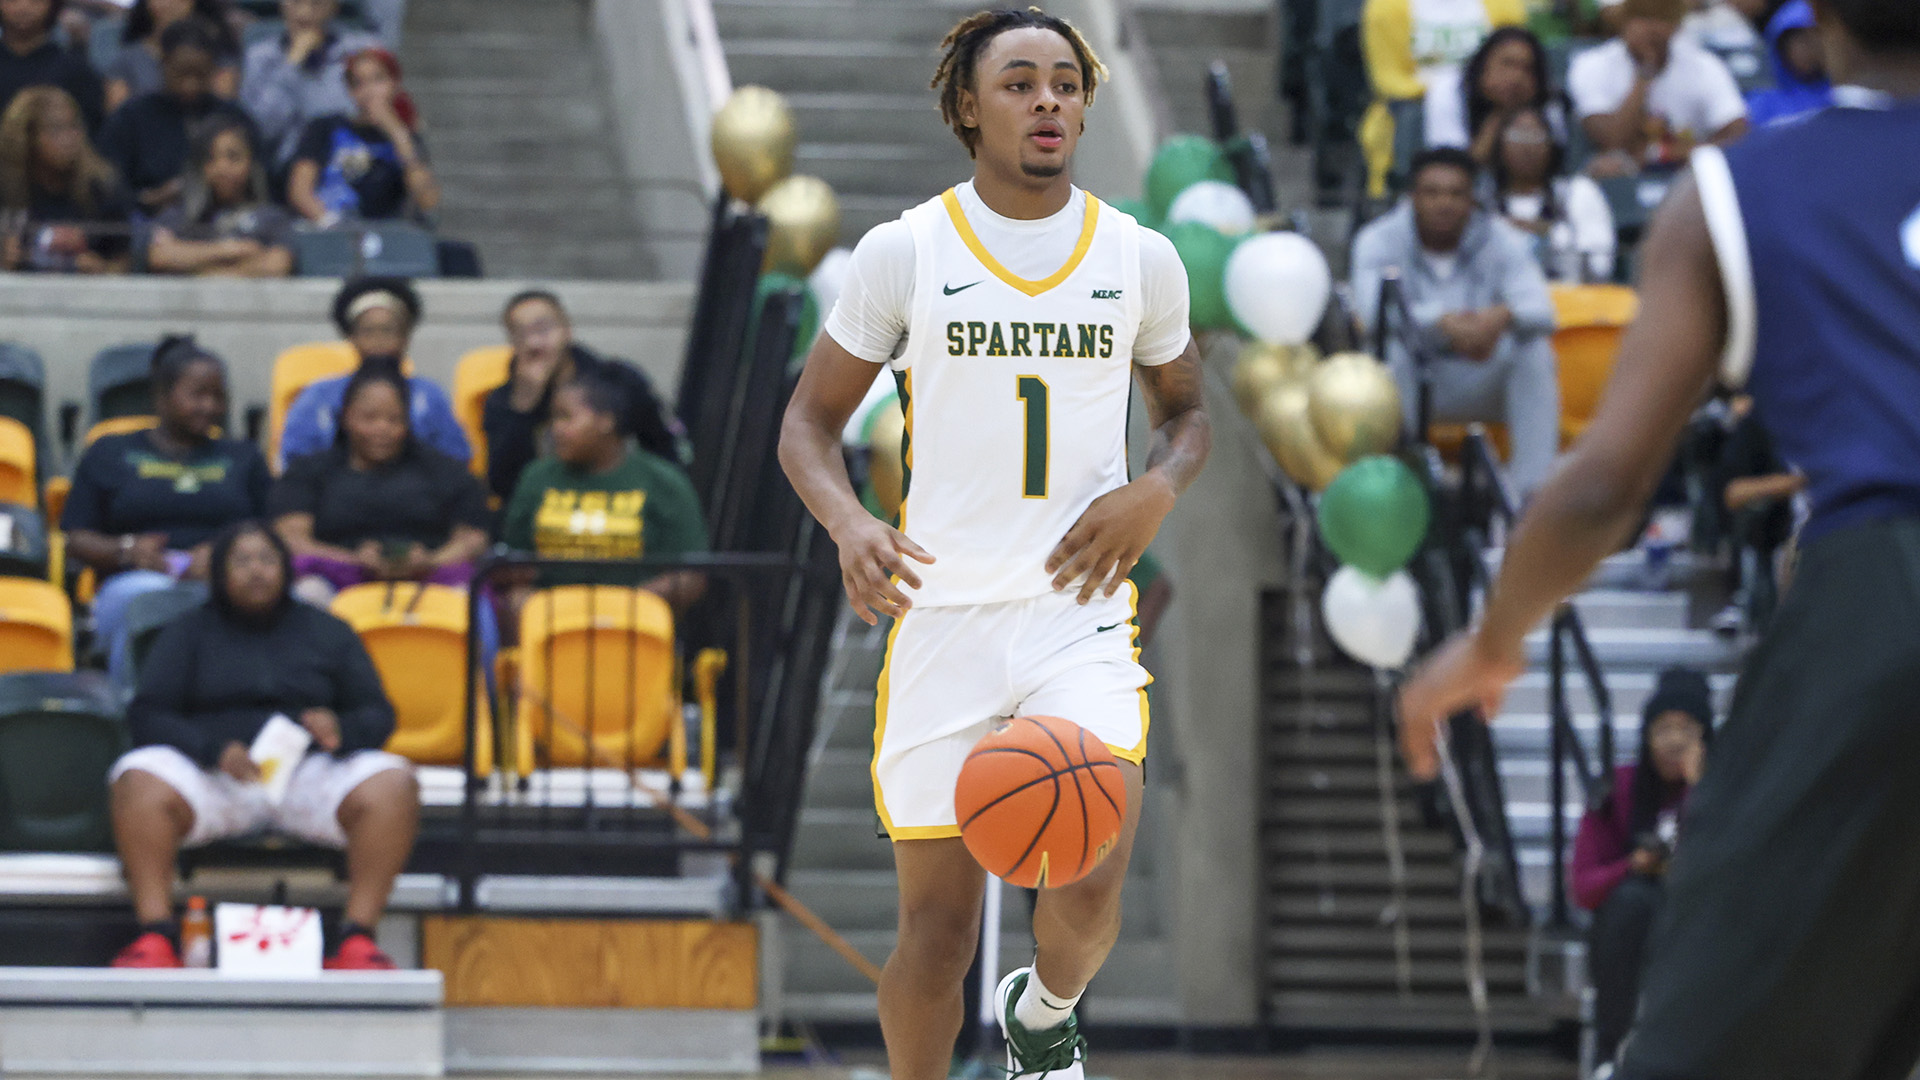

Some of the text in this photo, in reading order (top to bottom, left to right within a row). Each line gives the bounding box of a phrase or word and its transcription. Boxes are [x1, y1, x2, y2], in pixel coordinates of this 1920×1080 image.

[1091, 289, 1123, 300] MEAC
[946, 321, 1114, 359] SPARTANS
[1016, 374, 1051, 500] 1
